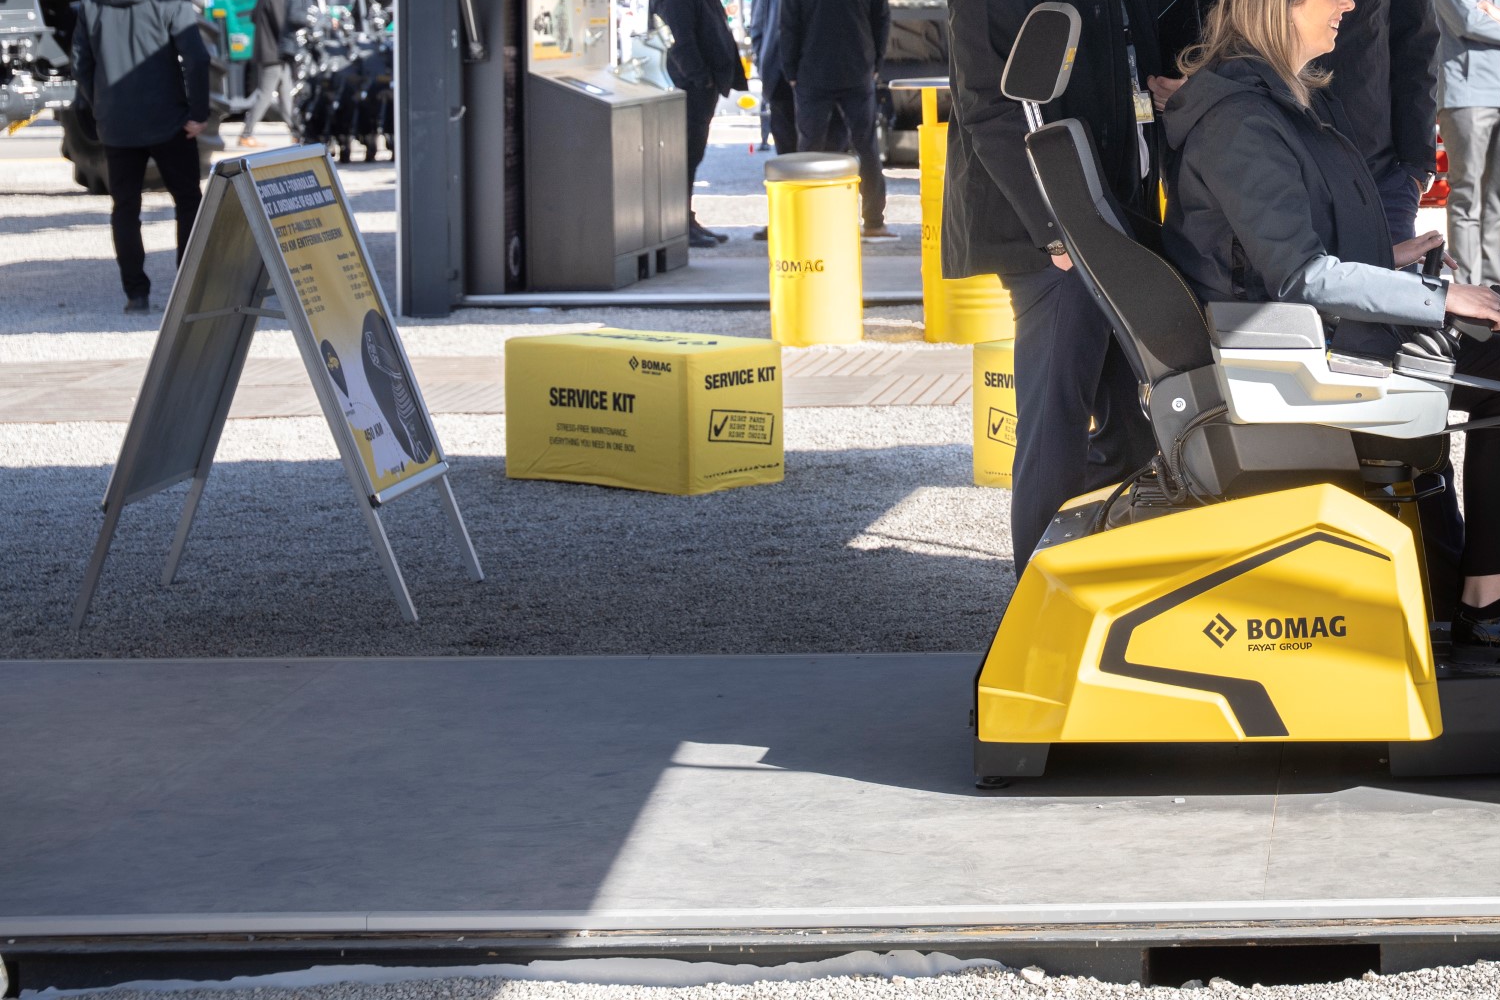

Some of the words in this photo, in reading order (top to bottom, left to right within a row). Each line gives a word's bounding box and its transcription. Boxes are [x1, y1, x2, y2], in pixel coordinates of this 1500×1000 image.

[776, 260, 824, 272] BOMAG
[642, 360, 672, 372] BOMAG
[704, 368, 754, 390] SERVICE
[758, 366, 776, 382] KIT
[984, 370, 1014, 389] SERVI
[550, 386, 608, 410] SERVICE
[612, 392, 636, 414] KIT
[730, 414, 746, 422] RIGHT
[556, 422, 590, 433] STRESS-FREE
[730, 422, 746, 430] RIGHT
[728, 430, 745, 438] RIGHT
[549, 436, 580, 446] EVERYTHING
[580, 438, 590, 448] YOU
[592, 440, 605, 448] NEED
[606, 441, 612, 450] IN
[612, 442, 623, 451] ONE
[1247, 616, 1346, 640] BOMAG
[1248, 644, 1276, 652] FAYAT
[1280, 642, 1312, 650] GROUP
